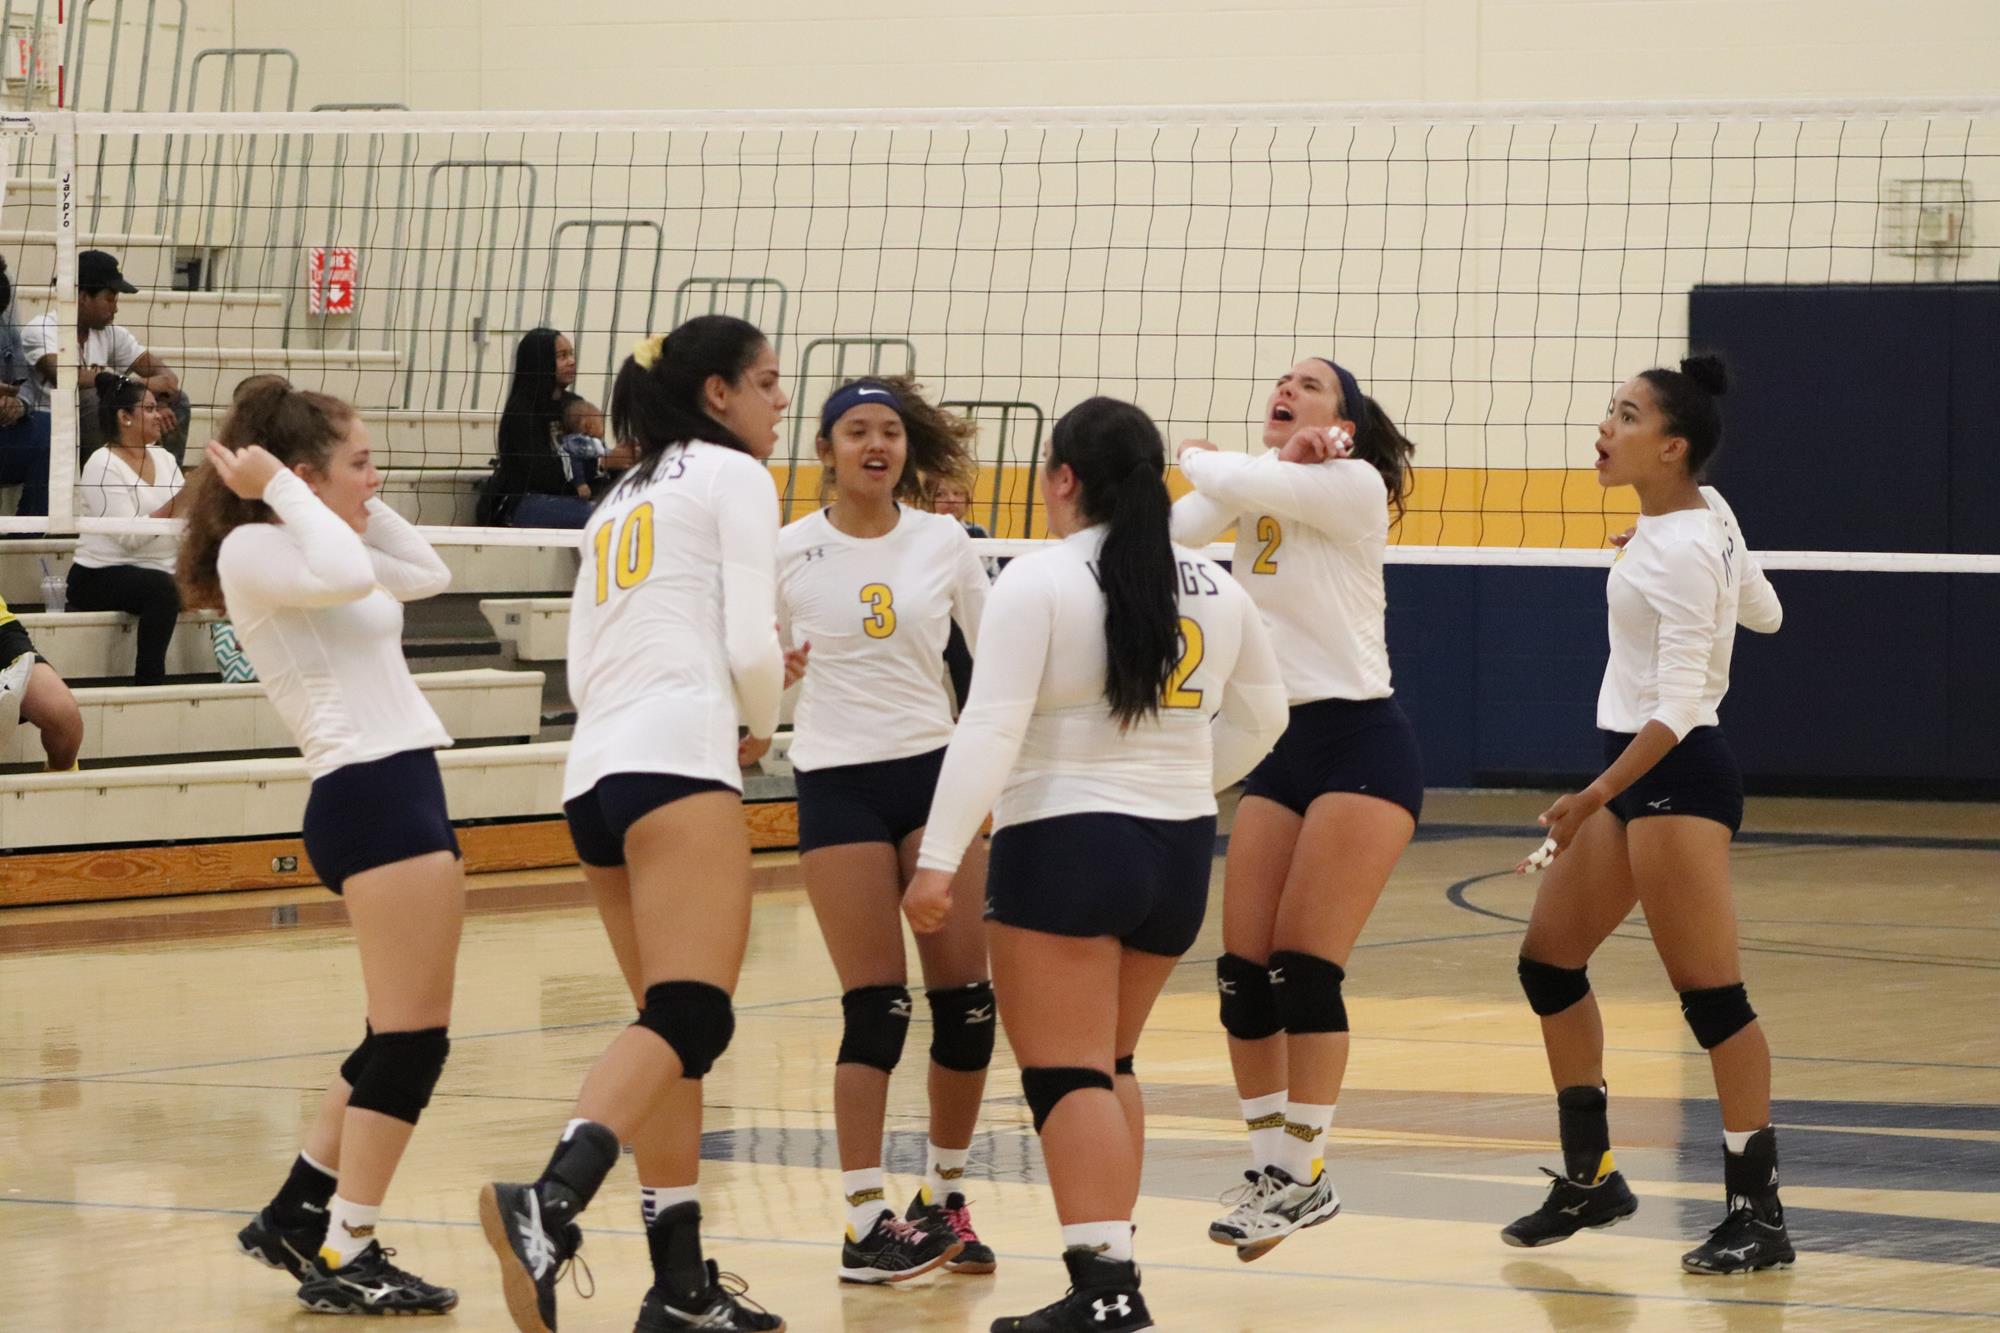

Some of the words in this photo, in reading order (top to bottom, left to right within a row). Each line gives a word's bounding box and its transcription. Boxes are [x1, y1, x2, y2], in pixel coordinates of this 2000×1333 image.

[62, 172, 71, 228] Jaypro
[594, 500, 655, 607] 10
[1251, 515, 1282, 575] 2
[859, 582, 897, 640] 3
